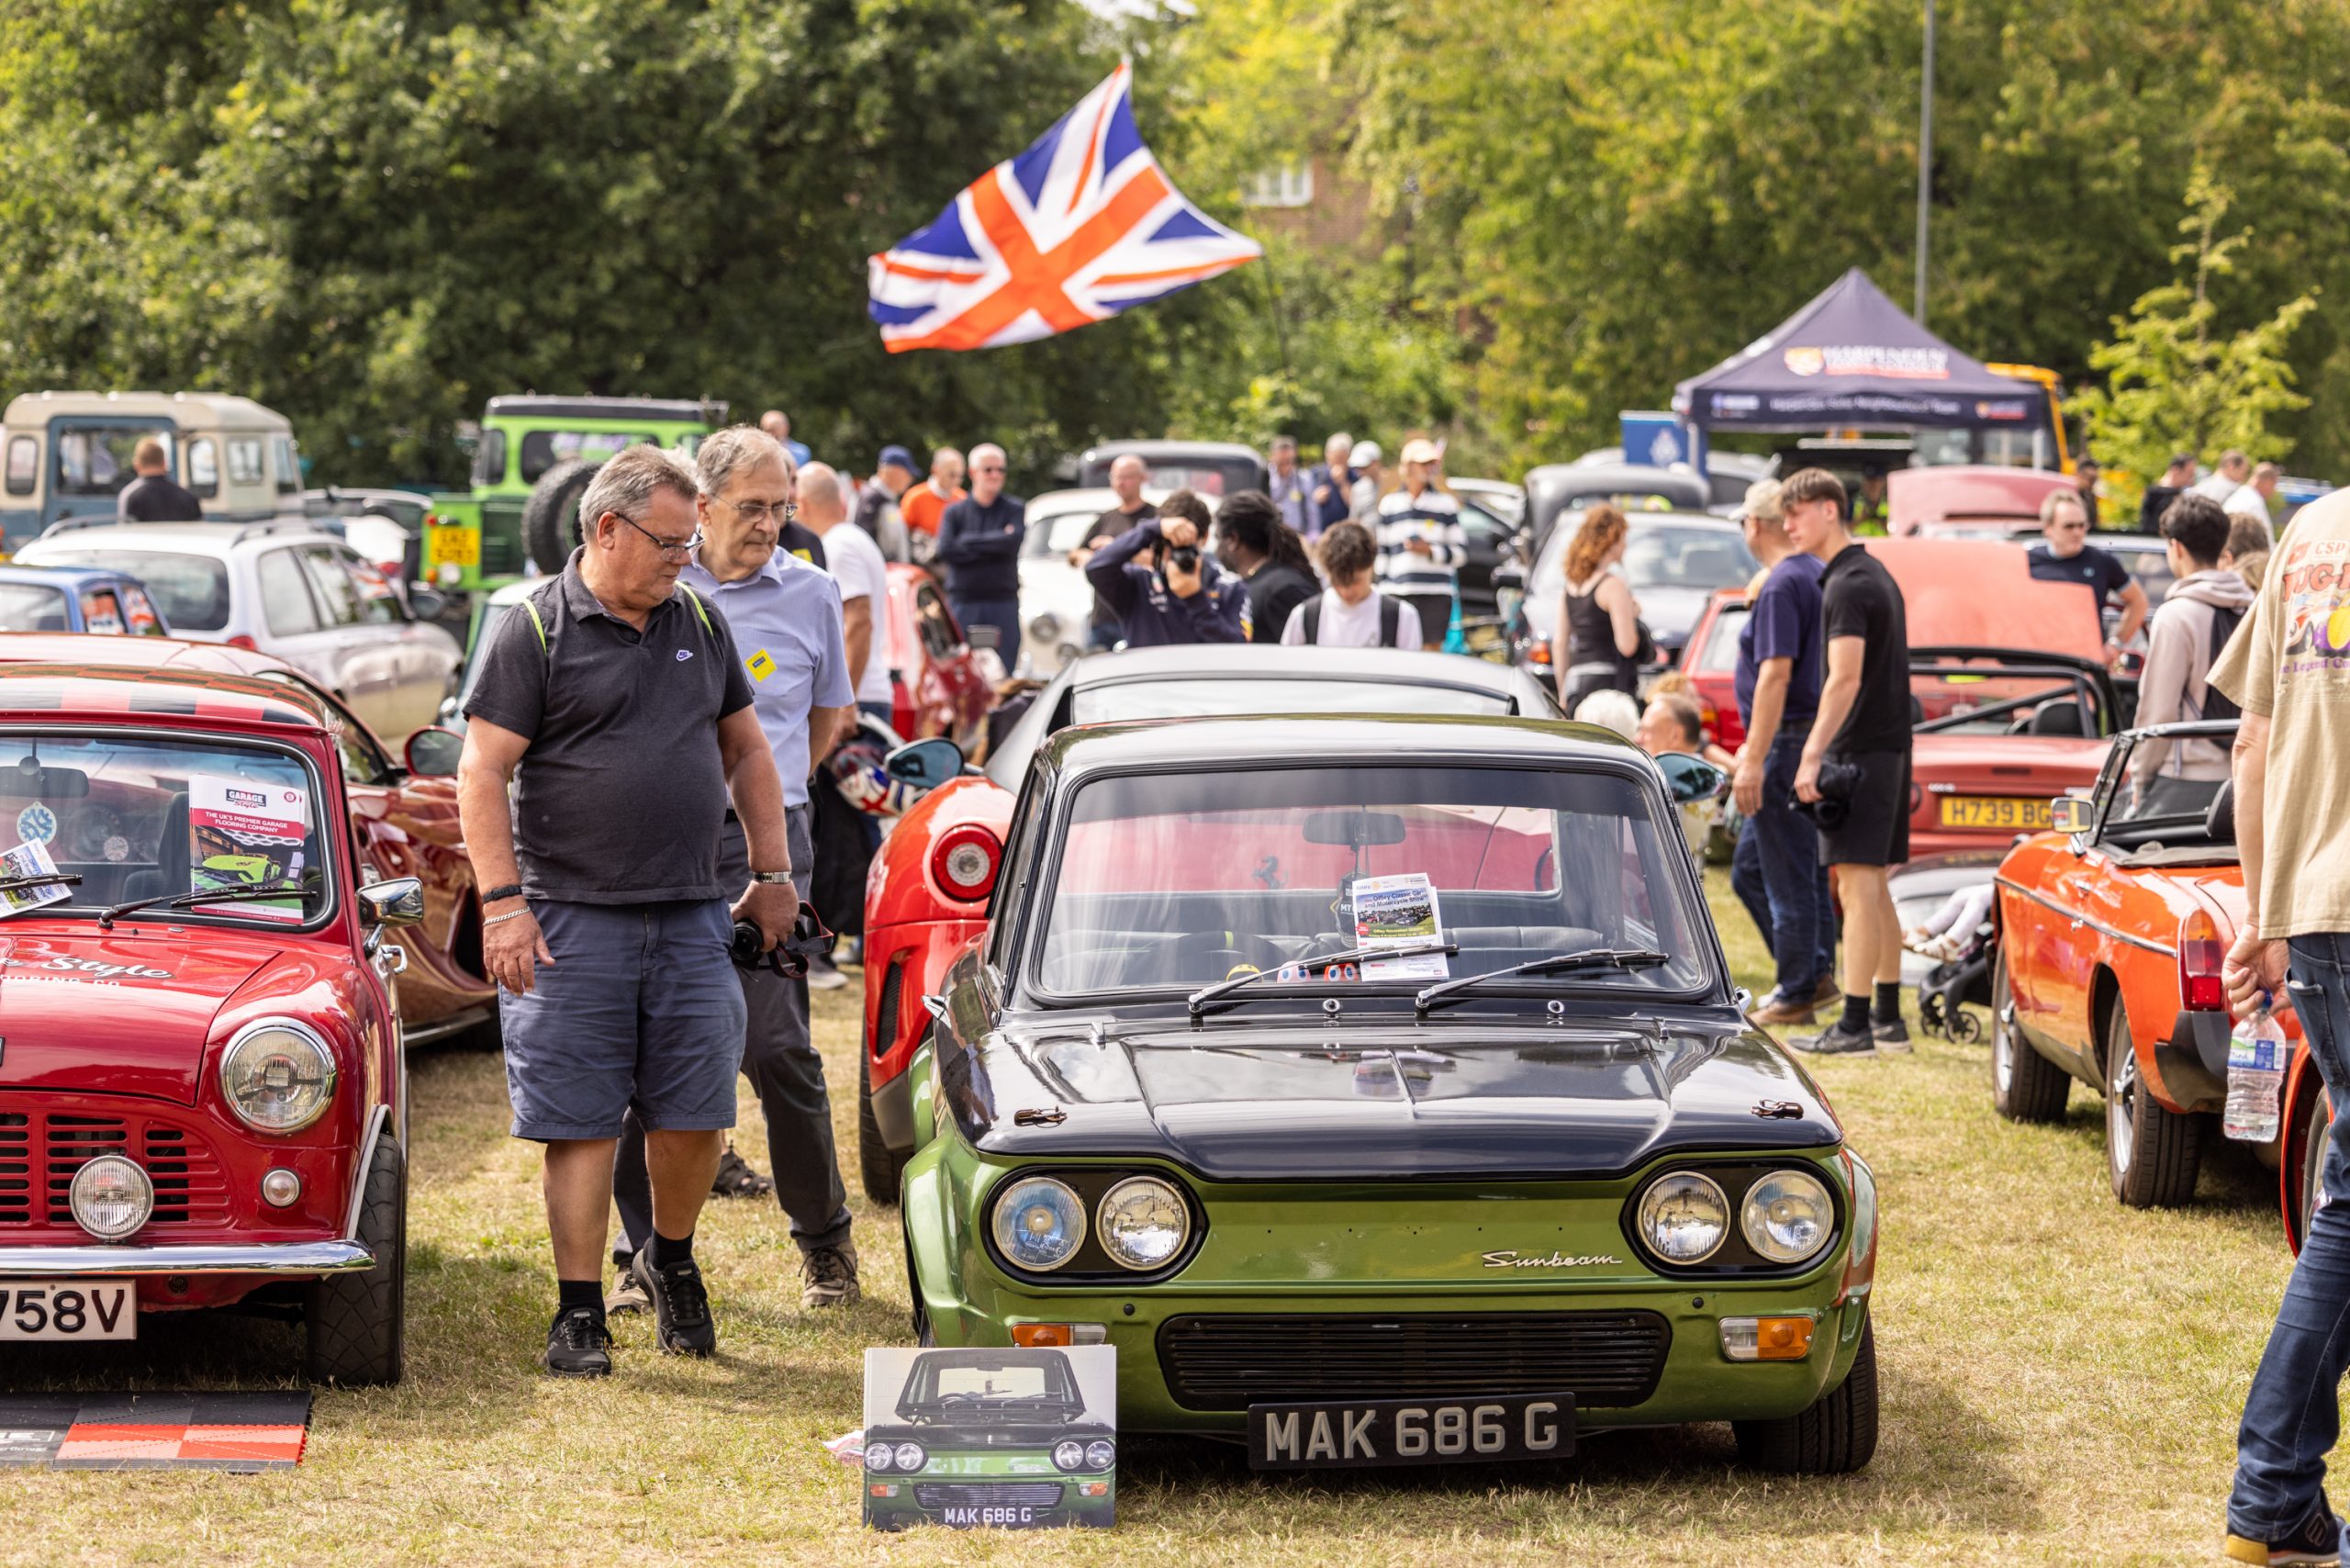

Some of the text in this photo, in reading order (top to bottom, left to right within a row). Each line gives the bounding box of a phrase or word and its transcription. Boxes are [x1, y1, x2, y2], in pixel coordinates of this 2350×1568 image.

[2315, 542, 2346, 554] CSP
[229, 790, 263, 802] GARAGE
[206, 811, 288, 829] THE UK'S PREMIER GARAGE
[1952, 801, 2053, 824] H739 BG
[215, 819, 278, 833] FLOORING COMPANY
[1377, 898, 1409, 908] Motorcycle
[41, 958, 173, 979] Style
[1482, 1250, 1622, 1268] Sunbeam
[1266, 1402, 1558, 1462] MAK 686 G
[945, 1506, 1032, 1523] MAK 686 G
